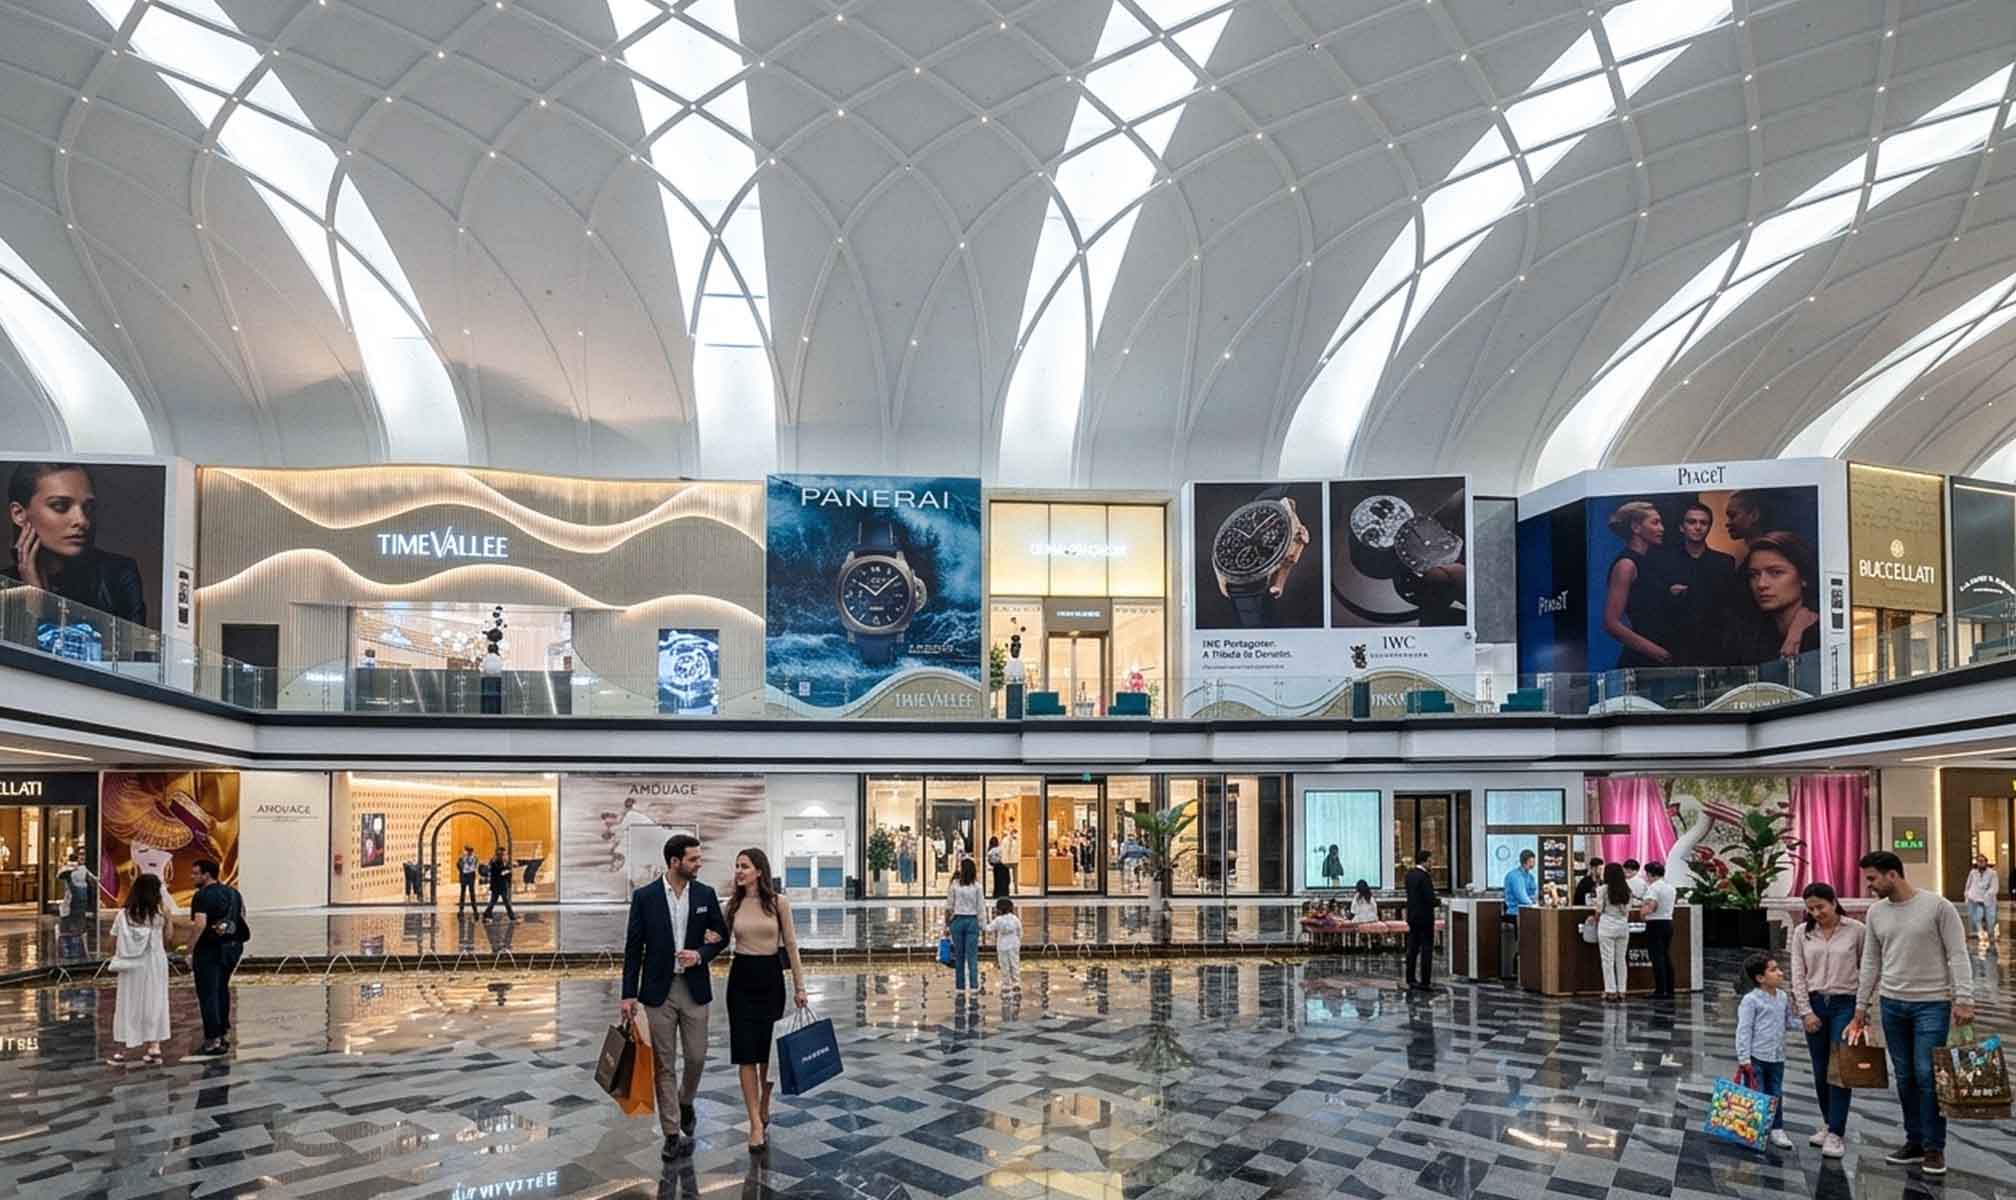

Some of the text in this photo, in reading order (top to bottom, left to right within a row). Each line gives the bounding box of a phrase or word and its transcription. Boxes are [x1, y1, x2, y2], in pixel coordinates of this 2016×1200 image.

[800, 488, 949, 509] PANERAI
[377, 525, 509, 558] TIMEVALLEE
[1858, 560, 1935, 584] BUCCELLATI
[1382, 636, 1416, 649] IWC
[630, 783, 698, 795] AMOUAGE
